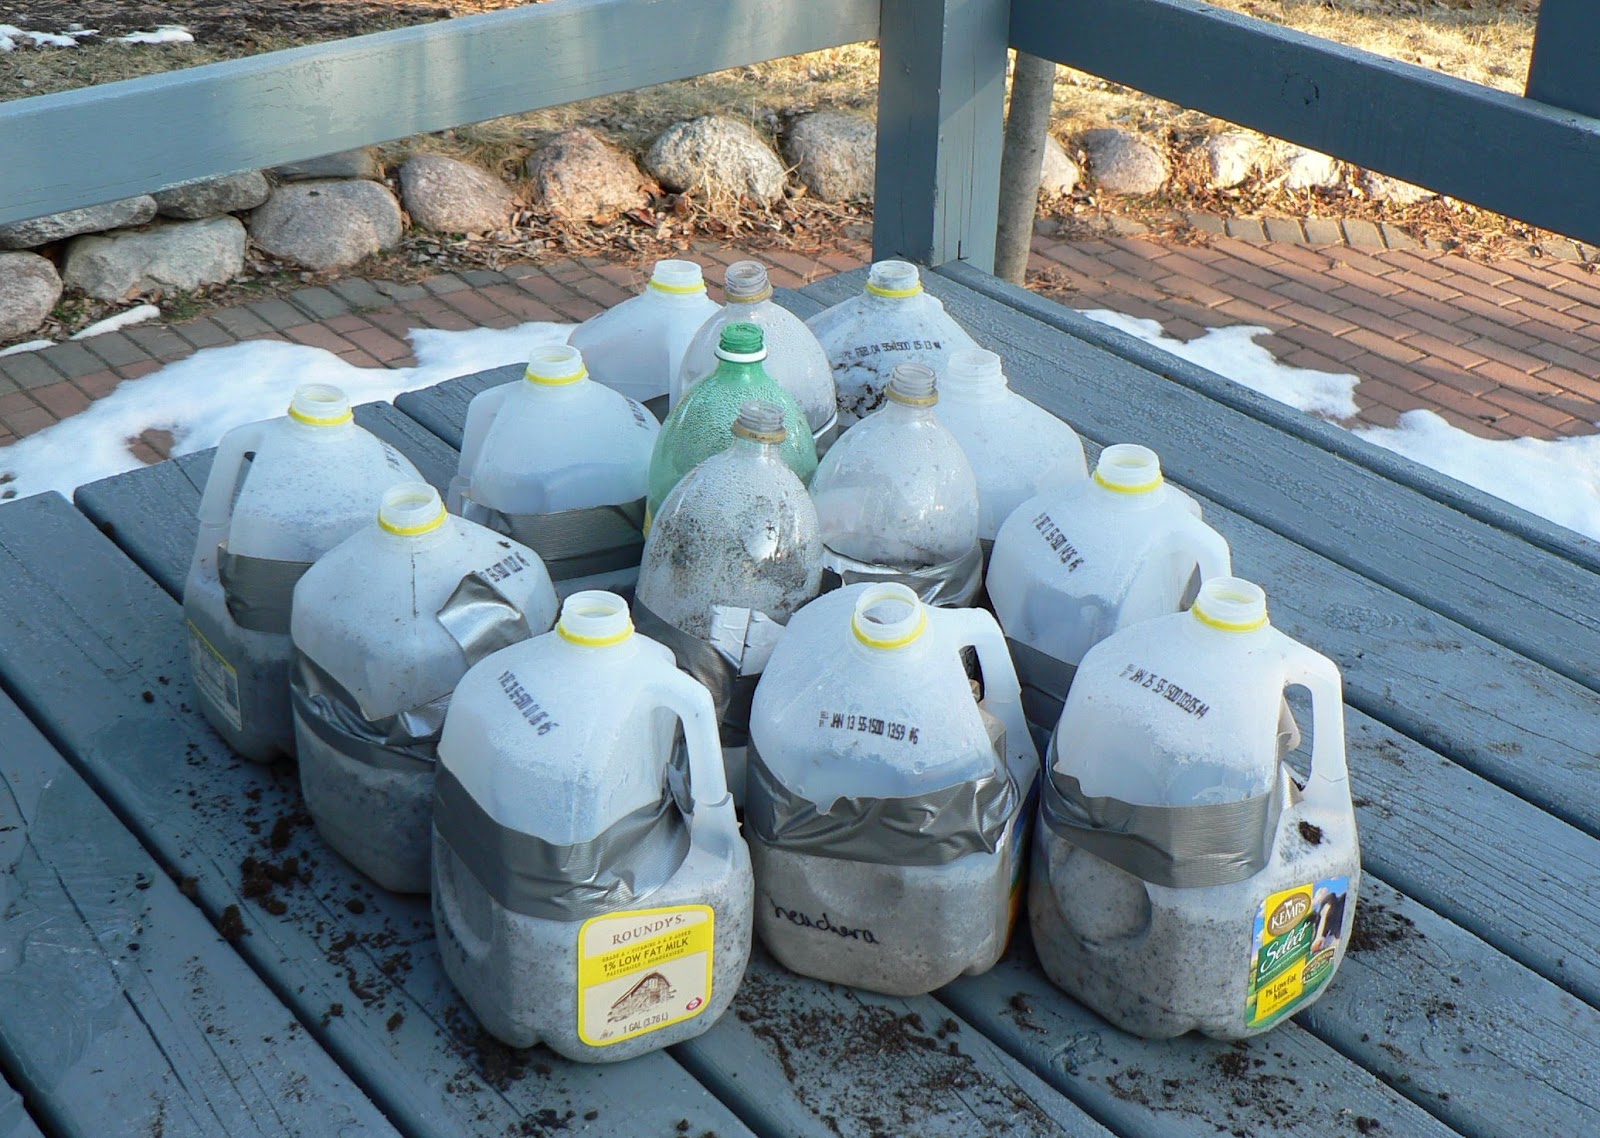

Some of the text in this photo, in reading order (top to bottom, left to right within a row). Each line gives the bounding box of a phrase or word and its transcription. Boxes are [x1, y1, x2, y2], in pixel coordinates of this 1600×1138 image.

[847, 714, 856, 730] 13
[1271, 900, 1306, 930] KEMPS
[602, 938, 689, 973] 1% LOW FAT MILK
[1260, 921, 1311, 974] Select
[629, 1021, 642, 1032] GAL
